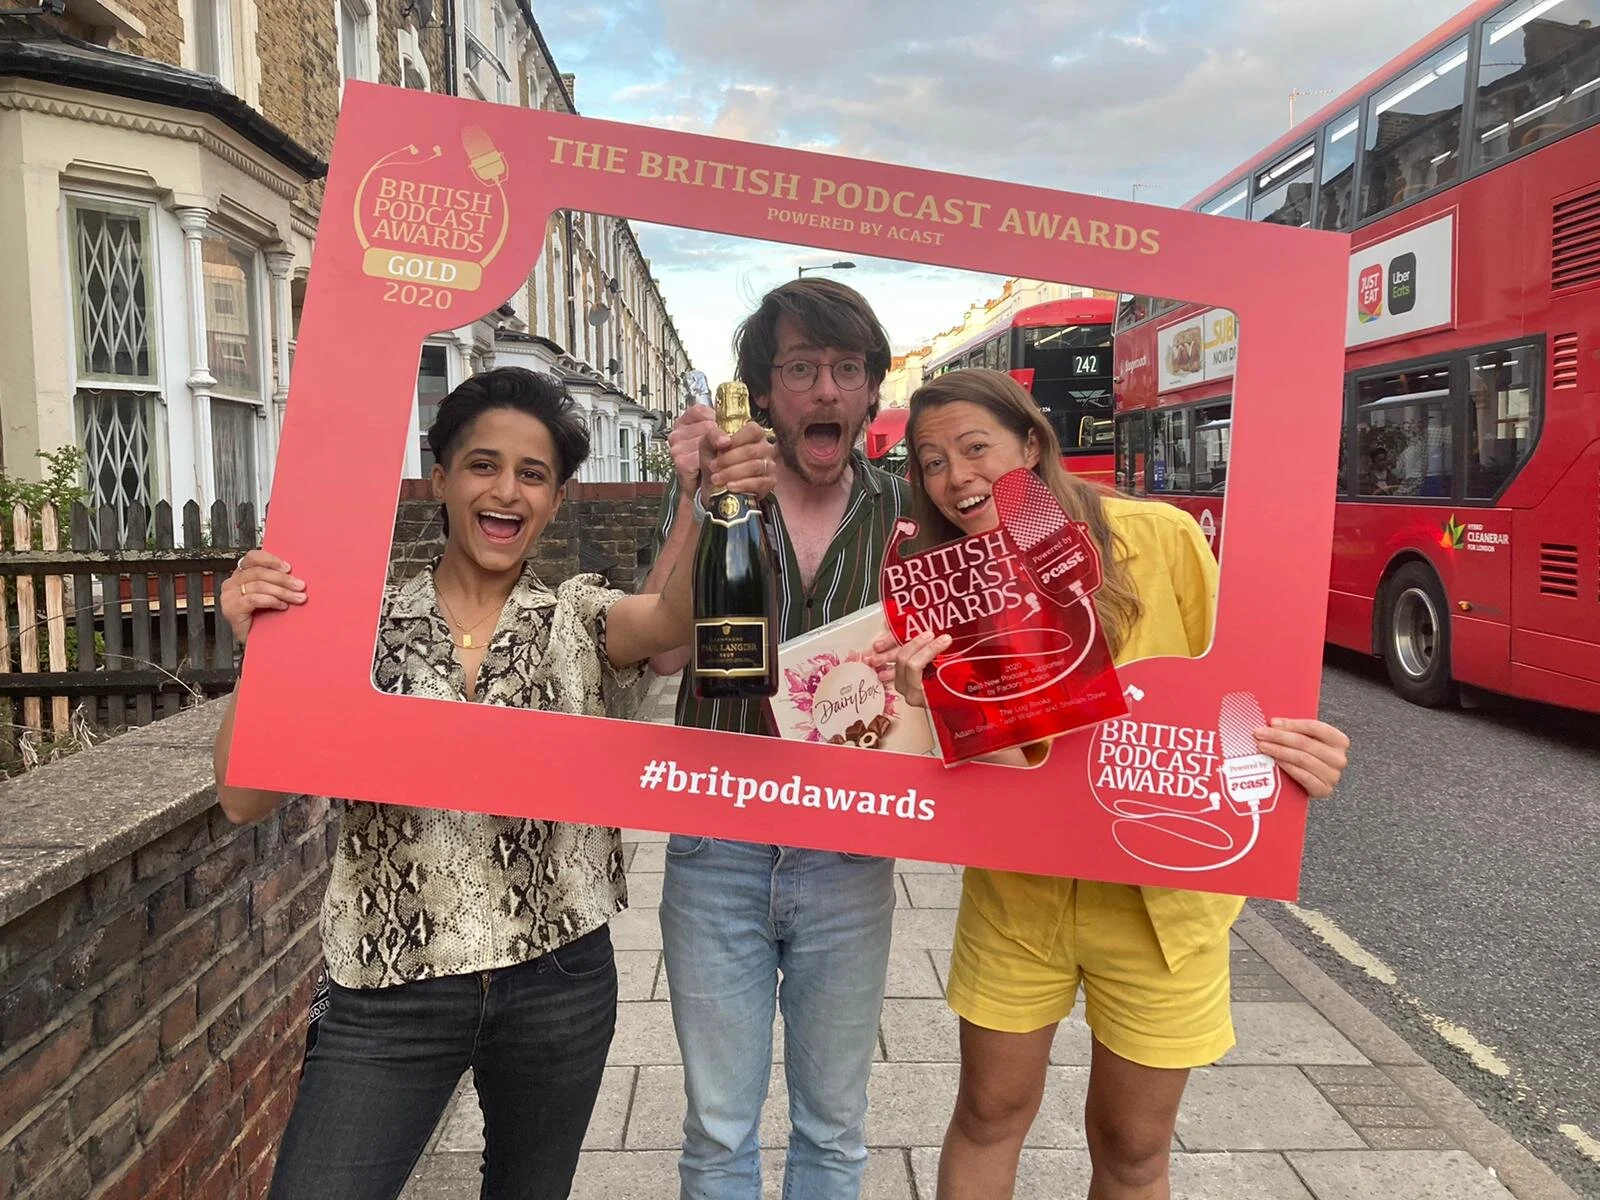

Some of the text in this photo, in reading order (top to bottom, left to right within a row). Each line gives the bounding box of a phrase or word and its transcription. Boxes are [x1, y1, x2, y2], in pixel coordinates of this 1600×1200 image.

[378, 178, 493, 215] BRITISH
[547, 135, 1162, 256] THE BRITISH PODCAST AWARDS
[372, 197, 493, 232] PODCAST
[767, 207, 945, 246] POWERED BY ACAST
[371, 217, 485, 254] AWARDS
[388, 255, 457, 283] GOLD
[1360, 272, 1380, 293] JUST
[1392, 270, 1411, 285] Uber
[383, 281, 453, 311] 2020
[1364, 287, 1379, 305] EAT
[1392, 284, 1410, 299] Eats
[1204, 315, 1237, 350] SUB
[1075, 355, 1097, 373] 242
[885, 529, 1011, 594] BRITISH
[1032, 535, 1073, 564] Powered by
[891, 554, 1020, 616] PODCAST
[1040, 551, 1085, 585] acast
[904, 581, 1023, 642] AWARDS
[1005, 661, 1022, 673] 2020
[1099, 718, 1217, 754] BRITISH
[1097, 741, 1219, 777] PODCAST
[1229, 761, 1258, 773] Powered
[639, 758, 937, 822] #britpodawards
[1095, 765, 1210, 800] AWARDS
[1231, 776, 1270, 791] acast
